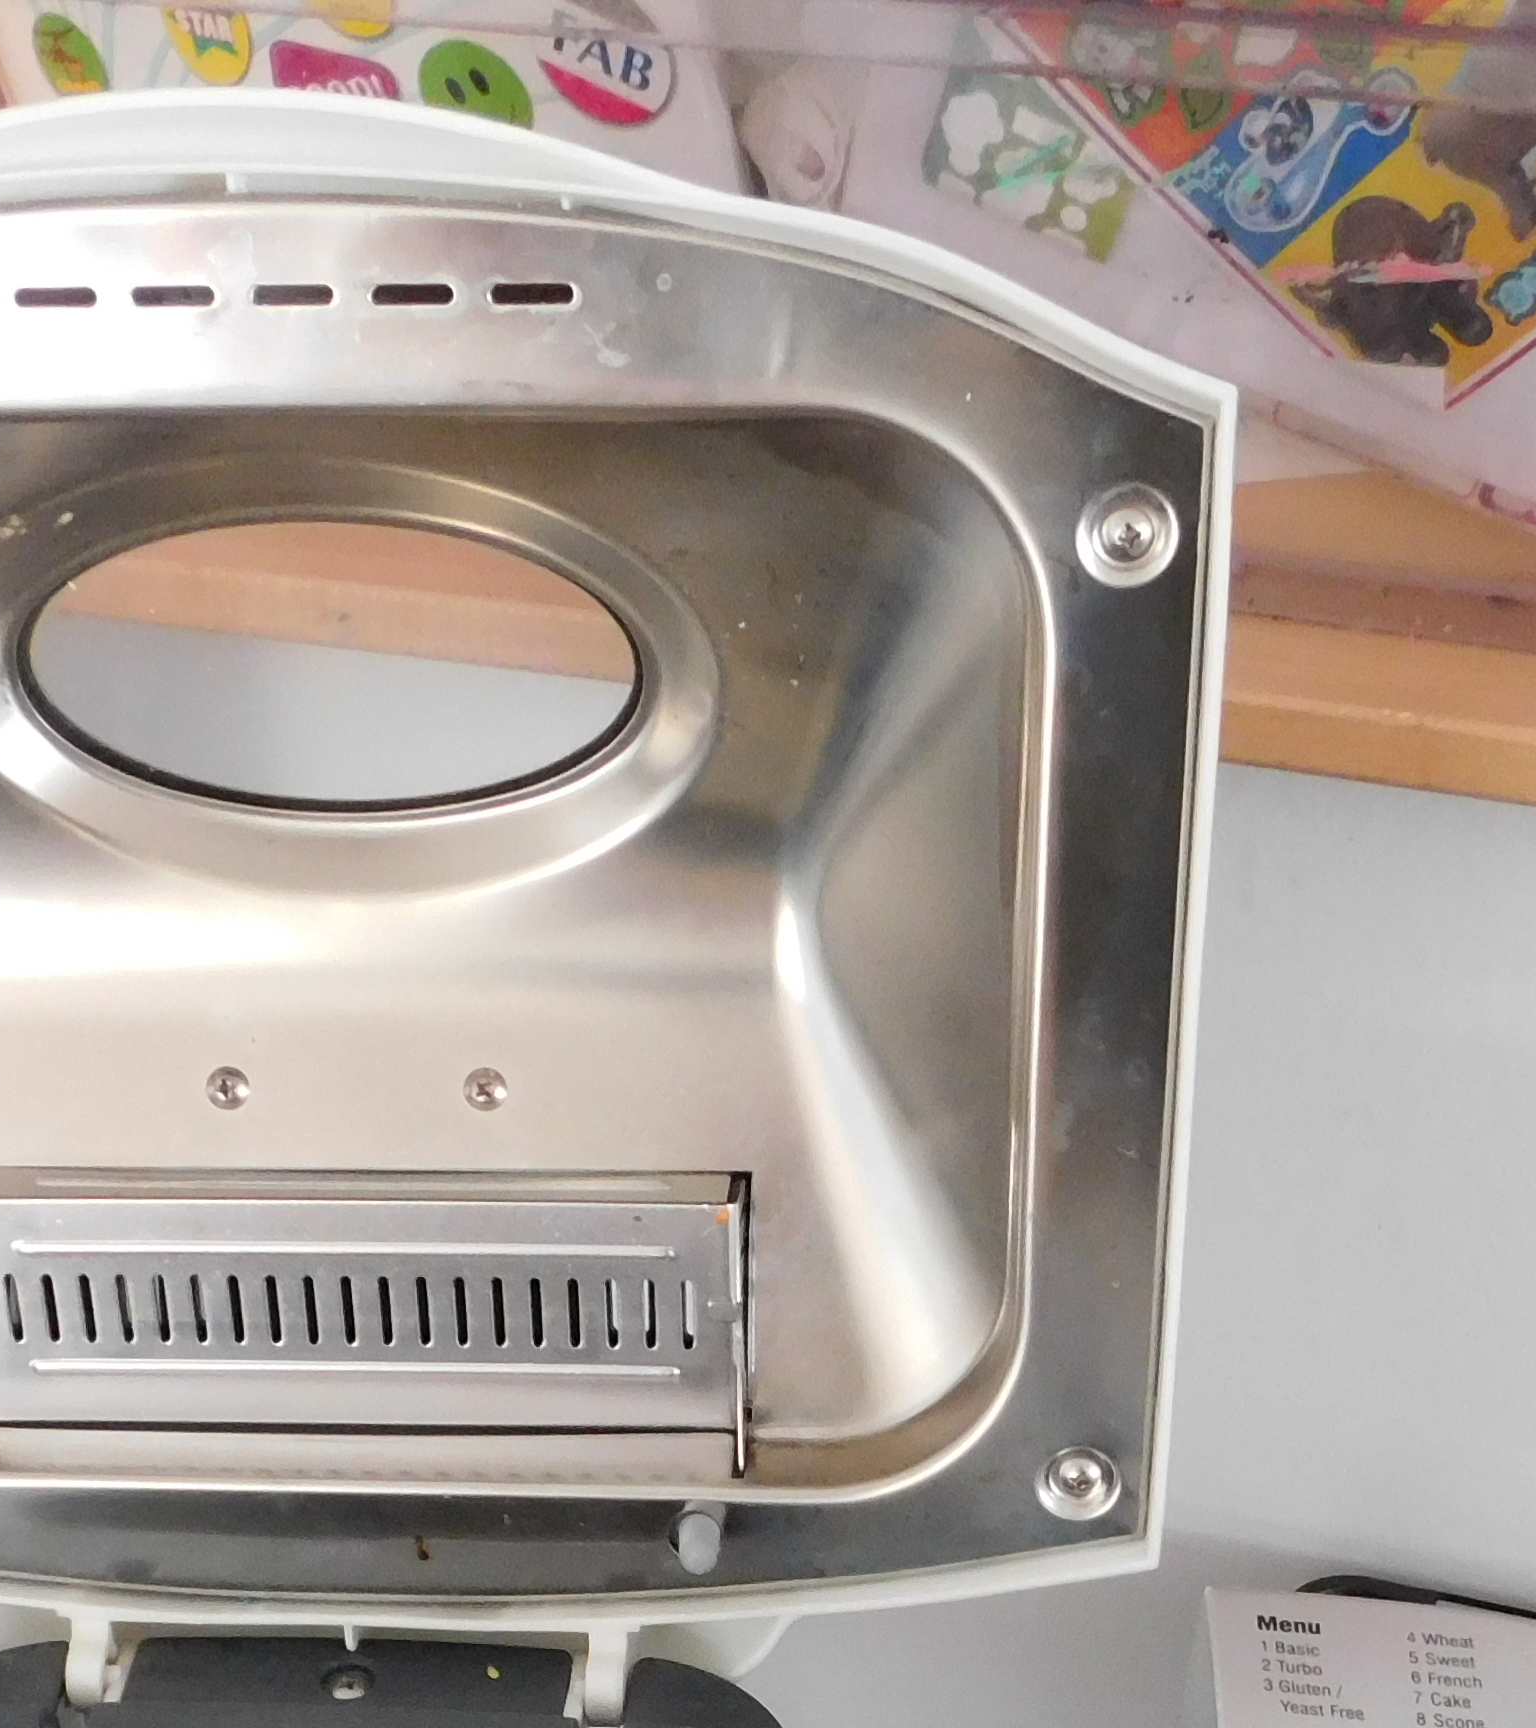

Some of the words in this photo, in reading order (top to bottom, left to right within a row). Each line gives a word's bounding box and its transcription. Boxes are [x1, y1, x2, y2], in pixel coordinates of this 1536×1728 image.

[1256, 1614, 1322, 1635] Menu
[1261, 1640, 1268, 1652] 1
[1275, 1640, 1321, 1657] Basic
[1407, 1631, 1417, 1643] 4
[1421, 1632, 1475, 1649] Wheat
[1261, 1659, 1271, 1672] 2
[1278, 1660, 1323, 1676] Turbo
[1408, 1651, 1419, 1664] 5
[1425, 1652, 1476, 1669] Sweet
[1263, 1678, 1274, 1692] 3
[1279, 1679, 1331, 1697] Gluten
[1410, 1671, 1421, 1684] 6
[1428, 1672, 1483, 1689] French
[1414, 1691, 1423, 1704] 7
[1430, 1692, 1471, 1709] Cake
[1280, 1699, 1324, 1716] Yeast
[1330, 1705, 1366, 1721] Free
[1416, 1712, 1426, 1726] 8
